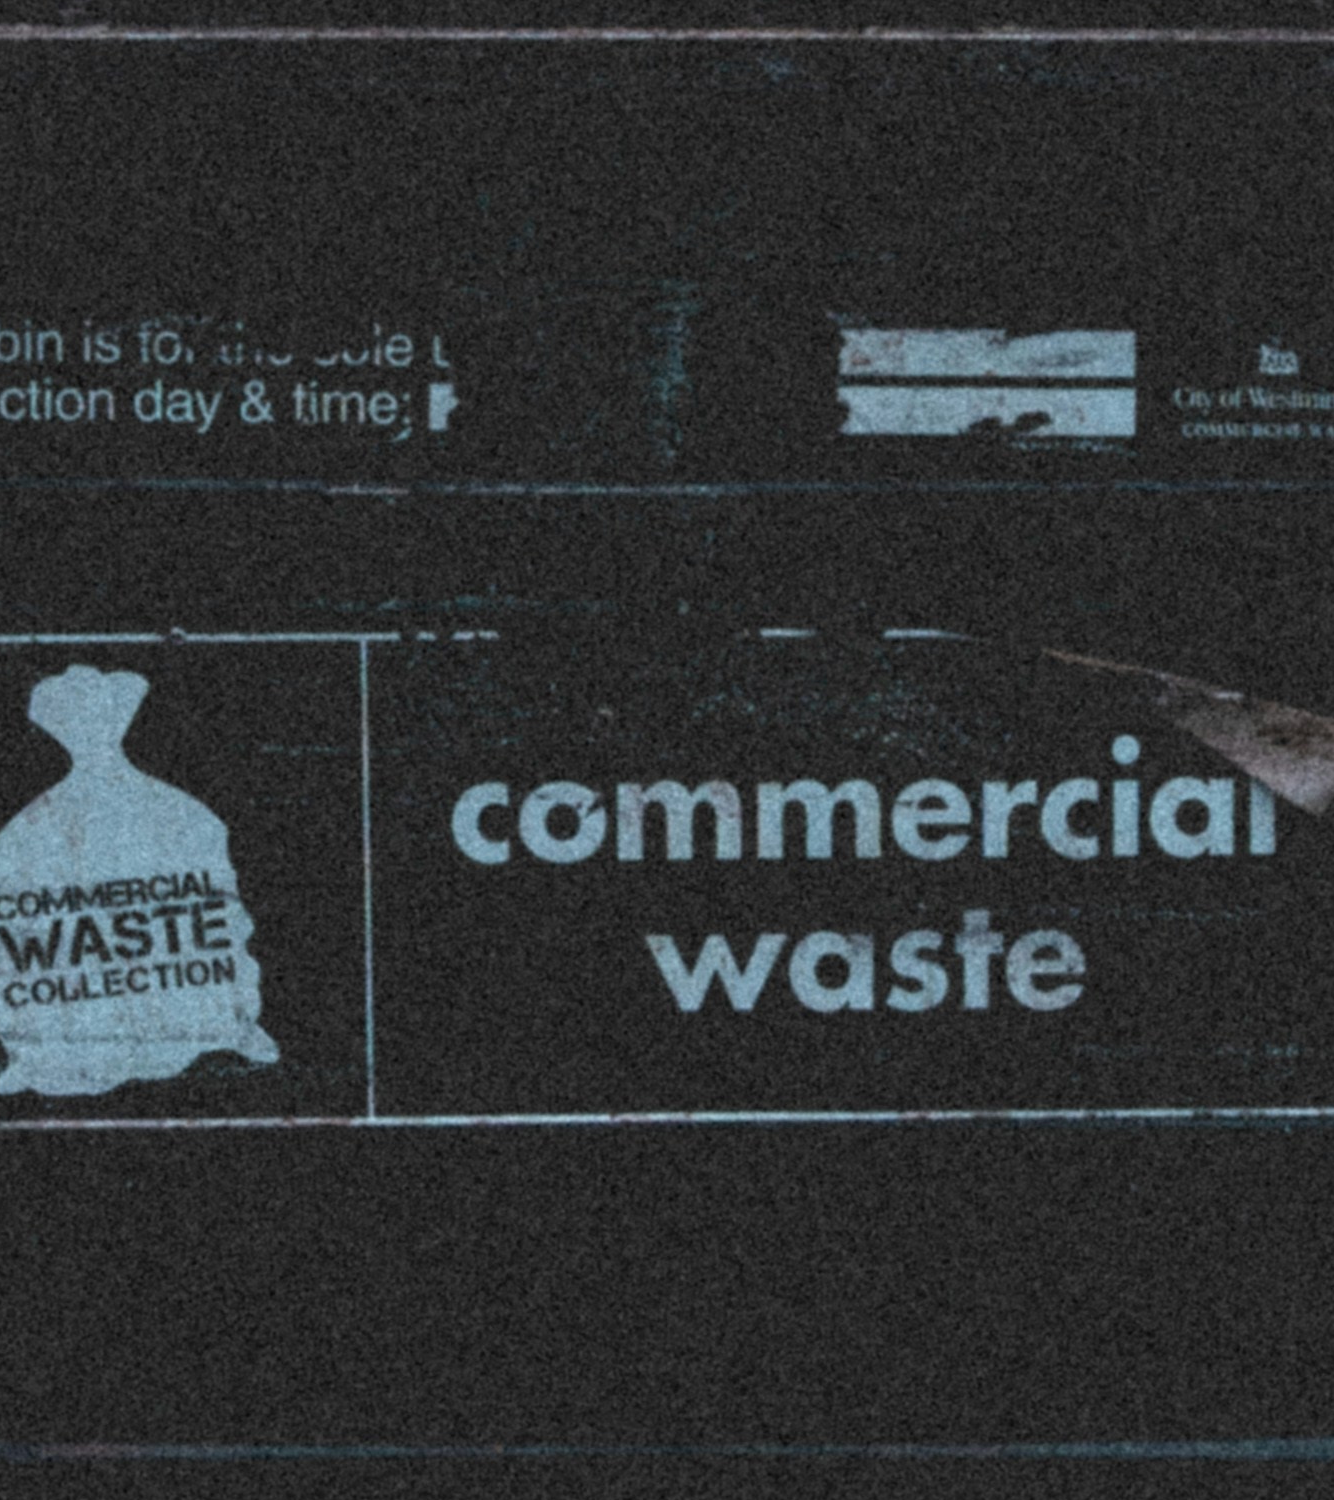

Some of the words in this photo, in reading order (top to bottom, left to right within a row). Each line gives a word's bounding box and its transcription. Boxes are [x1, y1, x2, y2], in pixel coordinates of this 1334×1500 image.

[82, 318, 121, 364] is
[133, 376, 224, 435] day
[239, 378, 274, 425] &
[451, 734, 1278, 866] commercial
[3, 956, 236, 1007] COLLECTION
[645, 909, 1087, 1012] waste
